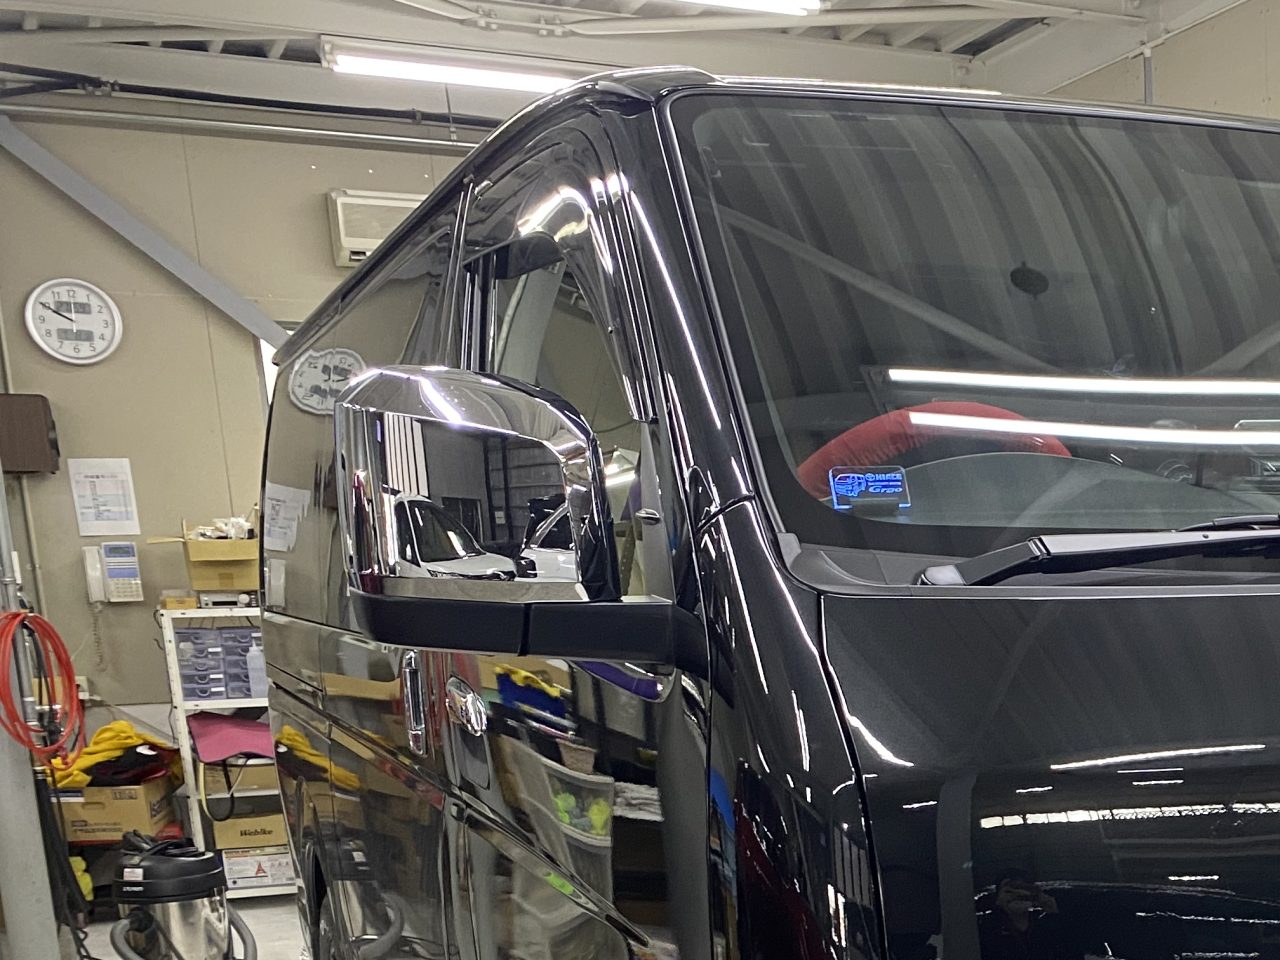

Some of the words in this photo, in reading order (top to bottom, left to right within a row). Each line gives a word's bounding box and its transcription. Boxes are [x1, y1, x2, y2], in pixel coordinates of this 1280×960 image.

[52, 291, 60, 299] 11
[67, 289, 76, 298] 12
[97, 305, 103, 313] 2
[39, 315, 45, 324] 9
[103, 320, 108, 328] 3
[45, 329, 52, 337] 8
[58, 341, 64, 349] 7
[73, 345, 80, 353] 6
[89, 343, 96, 352] 5
